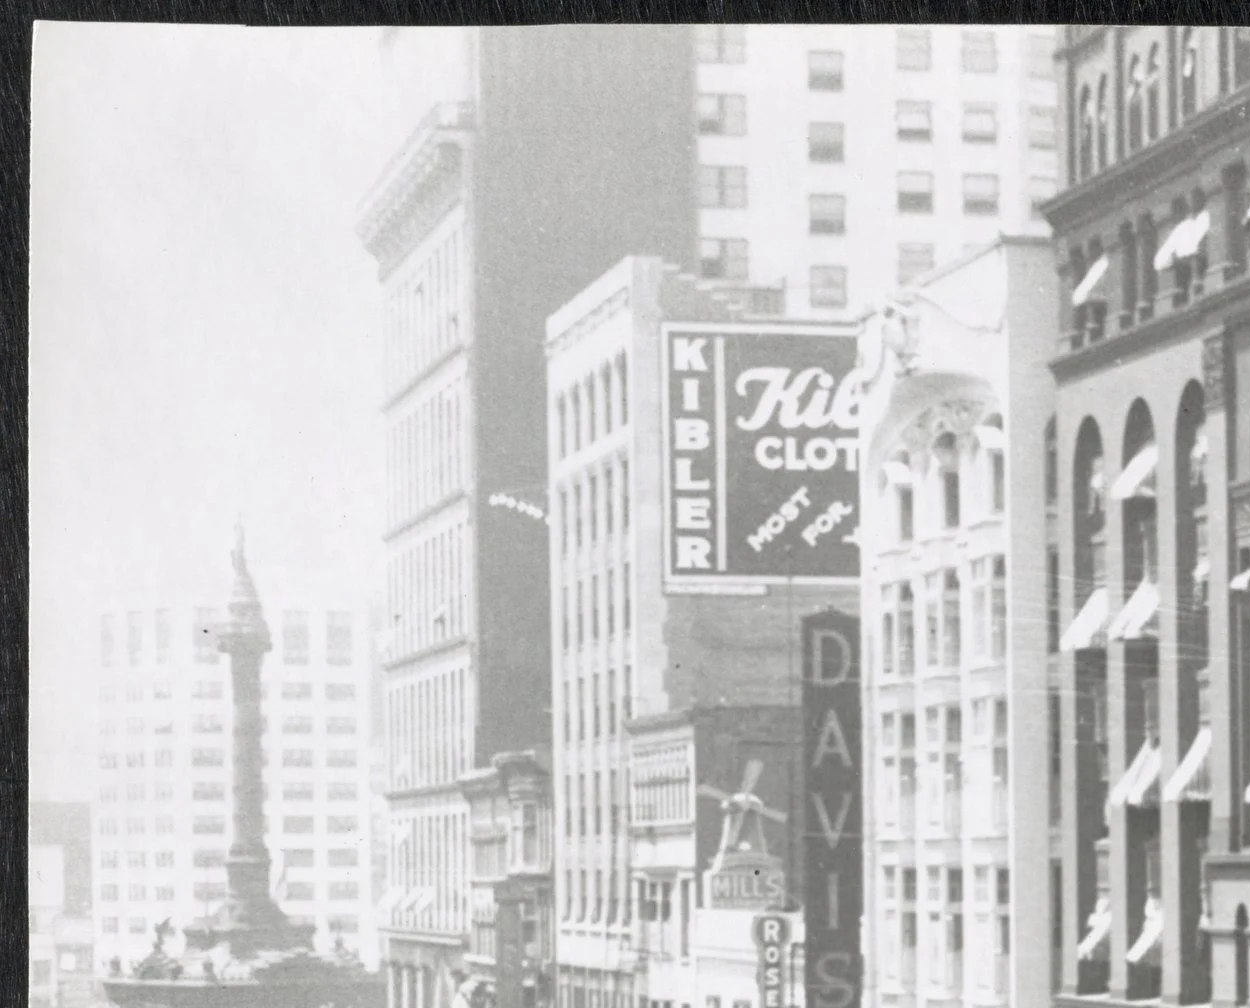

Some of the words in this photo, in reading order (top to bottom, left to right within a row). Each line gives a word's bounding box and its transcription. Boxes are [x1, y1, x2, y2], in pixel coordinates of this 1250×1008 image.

[672, 337, 712, 569] KIBLER
[755, 436, 860, 471] CLOT
[747, 486, 811, 552] MOST
[802, 501, 853, 547] FOR
[712, 875, 783, 898] MILLS
